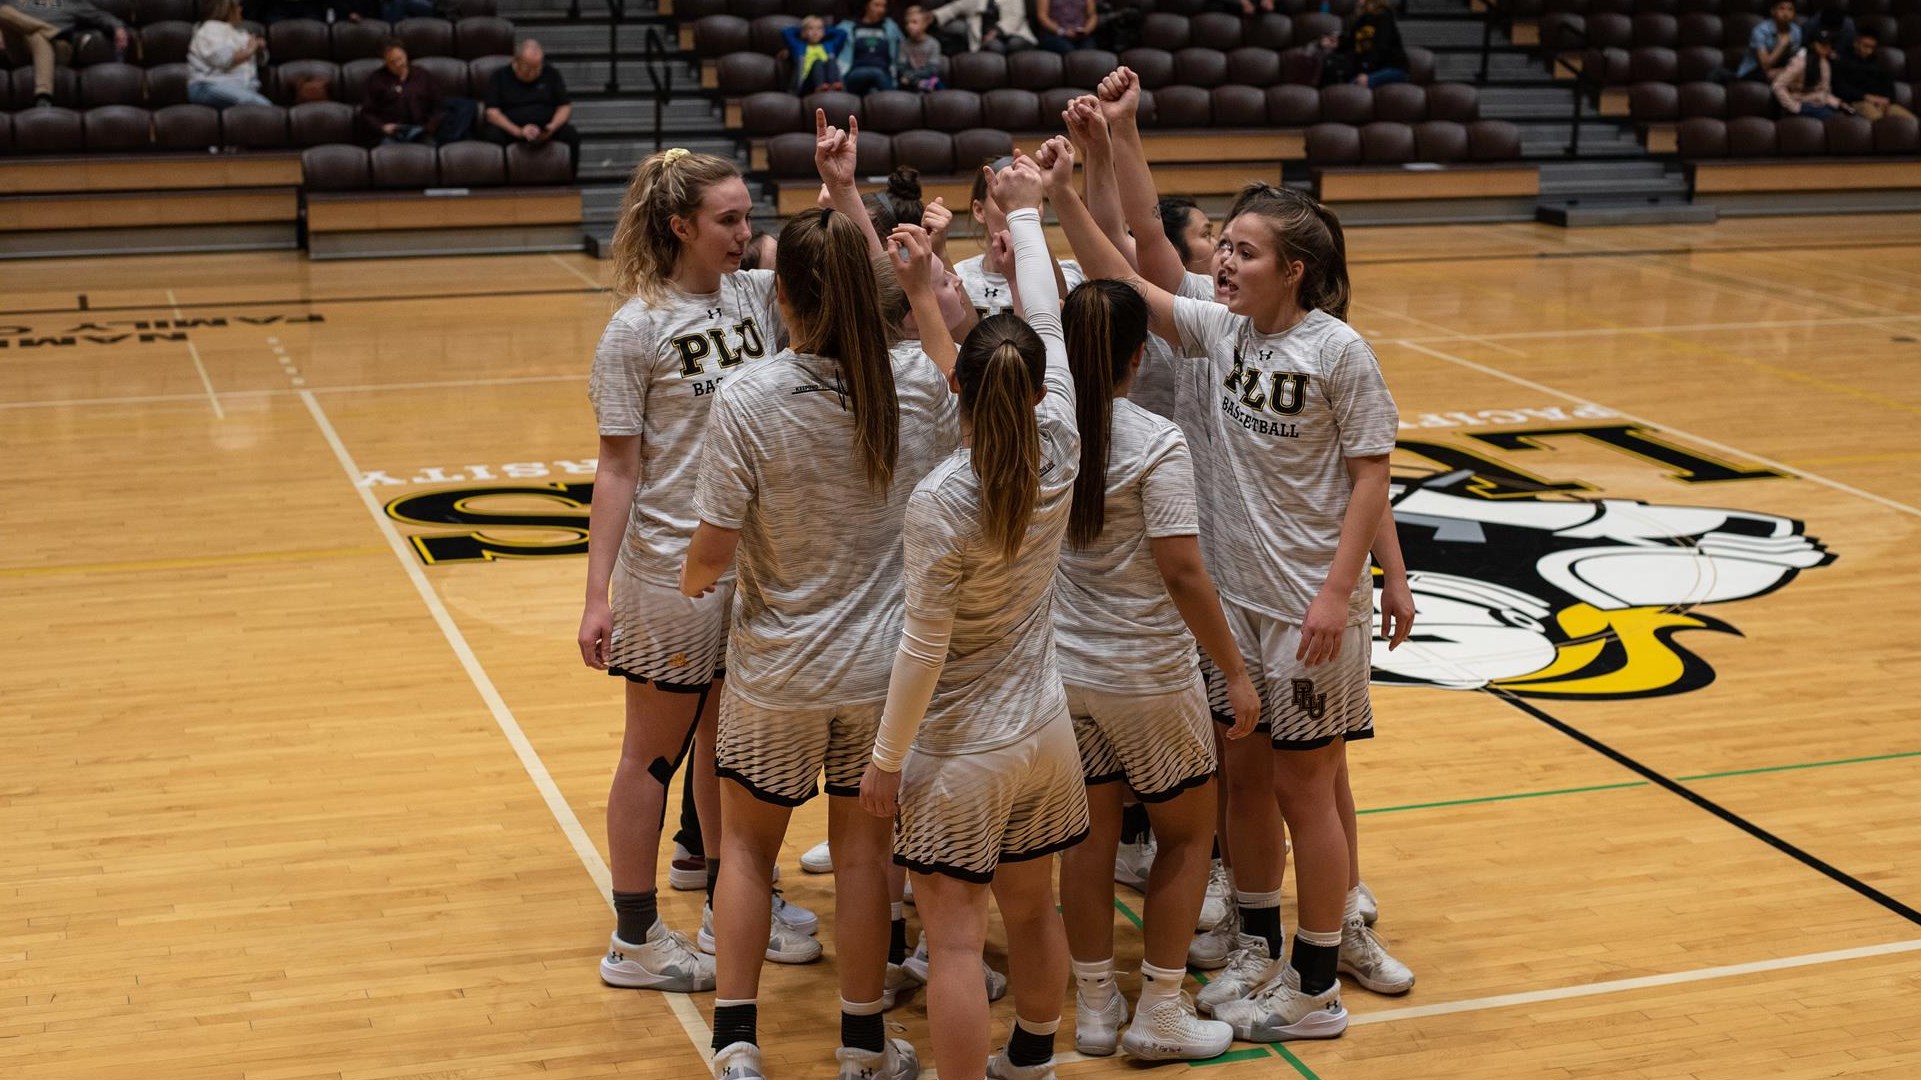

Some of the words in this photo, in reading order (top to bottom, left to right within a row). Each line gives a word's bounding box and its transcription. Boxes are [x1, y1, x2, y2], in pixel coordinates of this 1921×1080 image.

[64, 313, 326, 333] FAMILY
[0, 332, 188, 347] NAM
[671, 317, 765, 378] PLU
[1291, 679, 1327, 721] PLU
